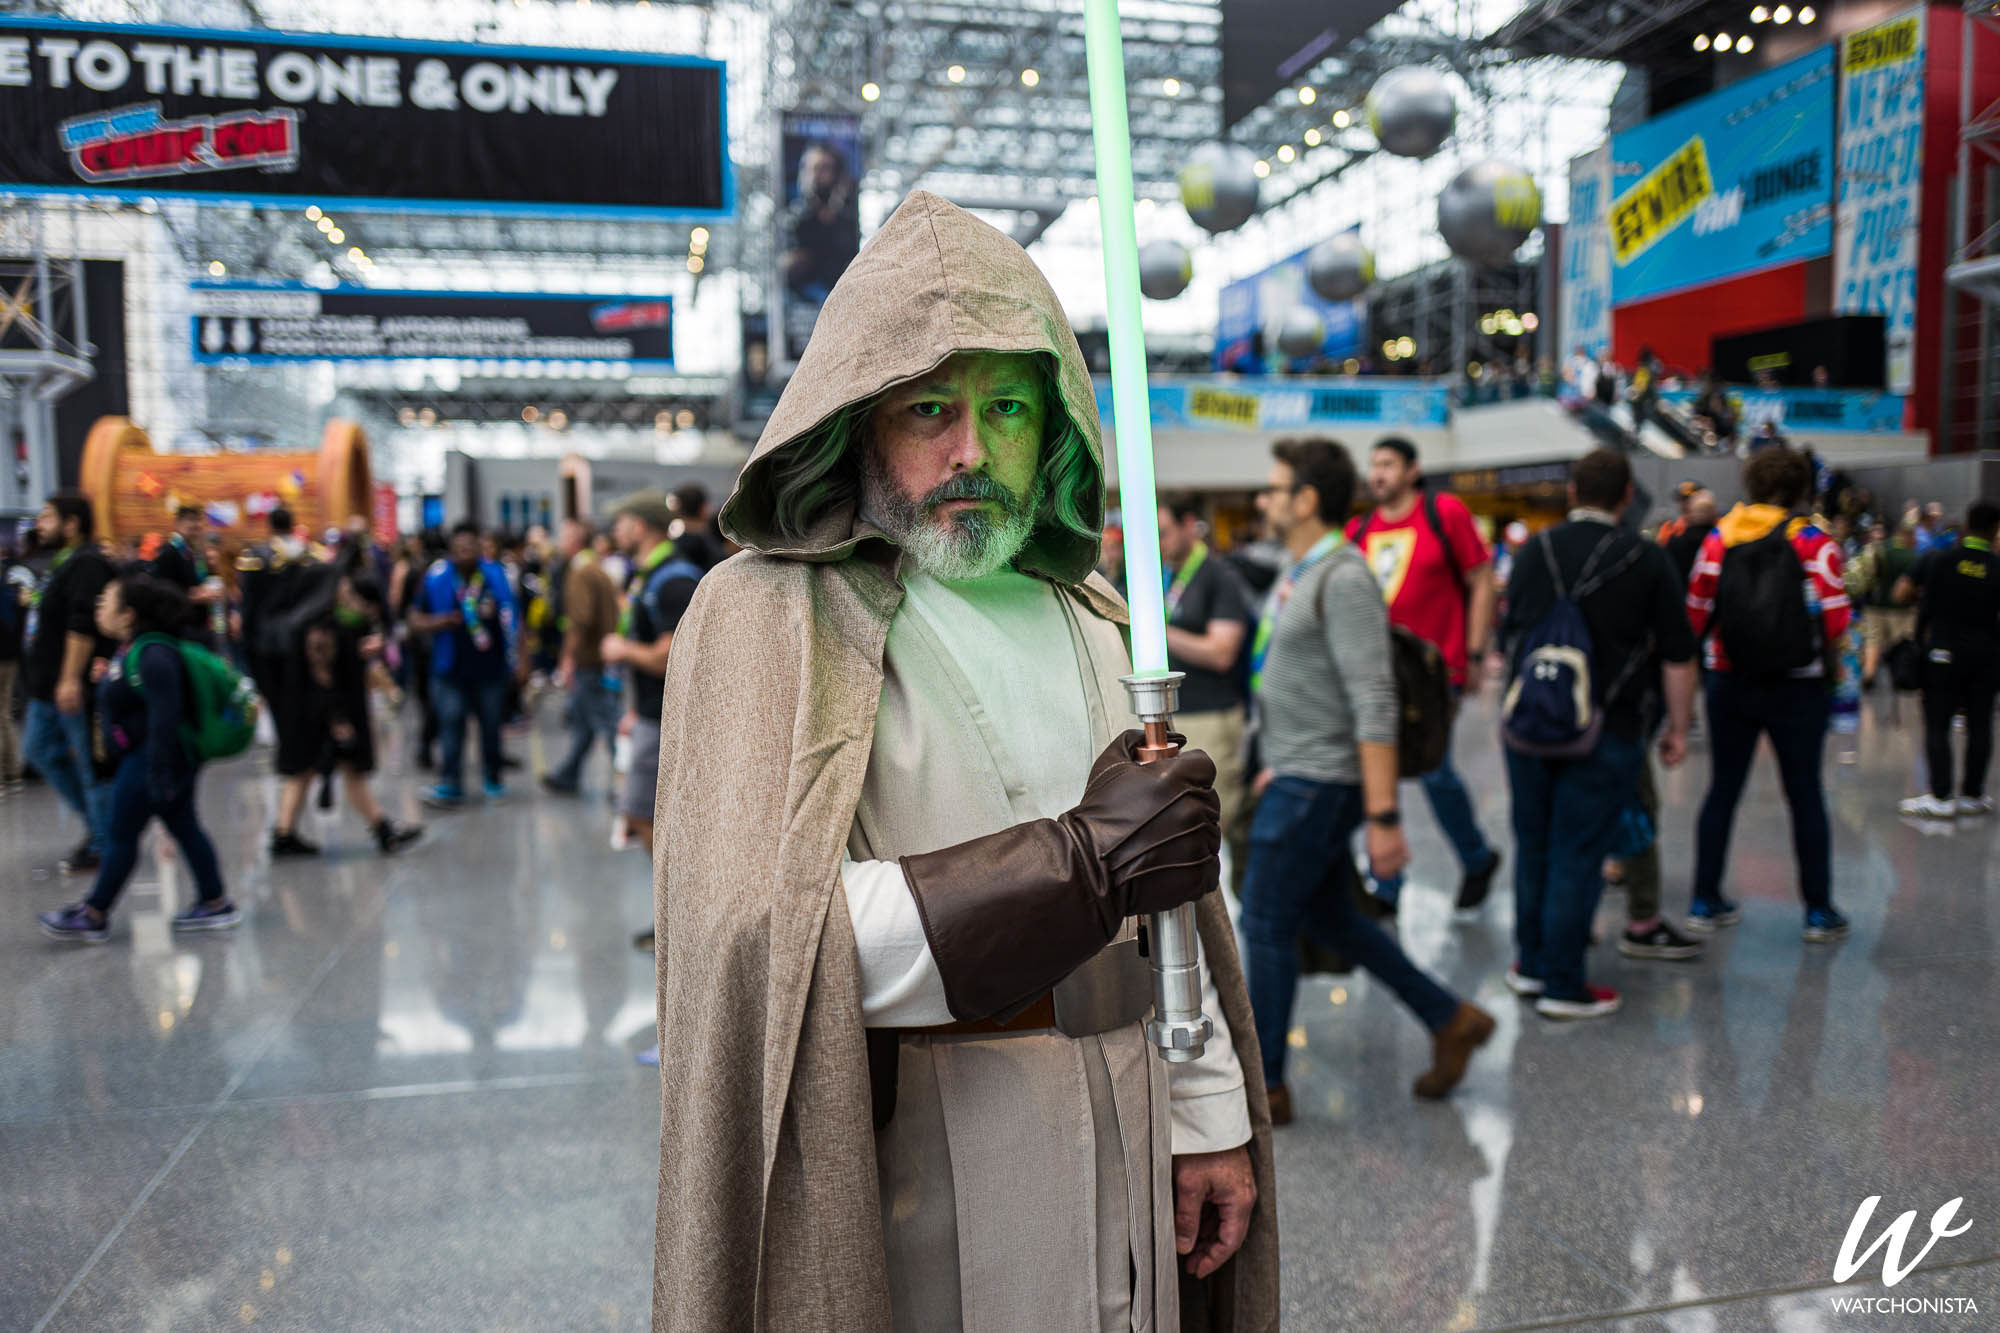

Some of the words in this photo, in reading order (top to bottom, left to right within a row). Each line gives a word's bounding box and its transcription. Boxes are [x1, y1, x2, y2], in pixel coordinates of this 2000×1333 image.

[38, 37, 130, 91] TO
[132, 42, 260, 99] THE
[266, 52, 402, 107] ONE
[409, 58, 459, 110] &
[461, 61, 618, 117] ONLY
